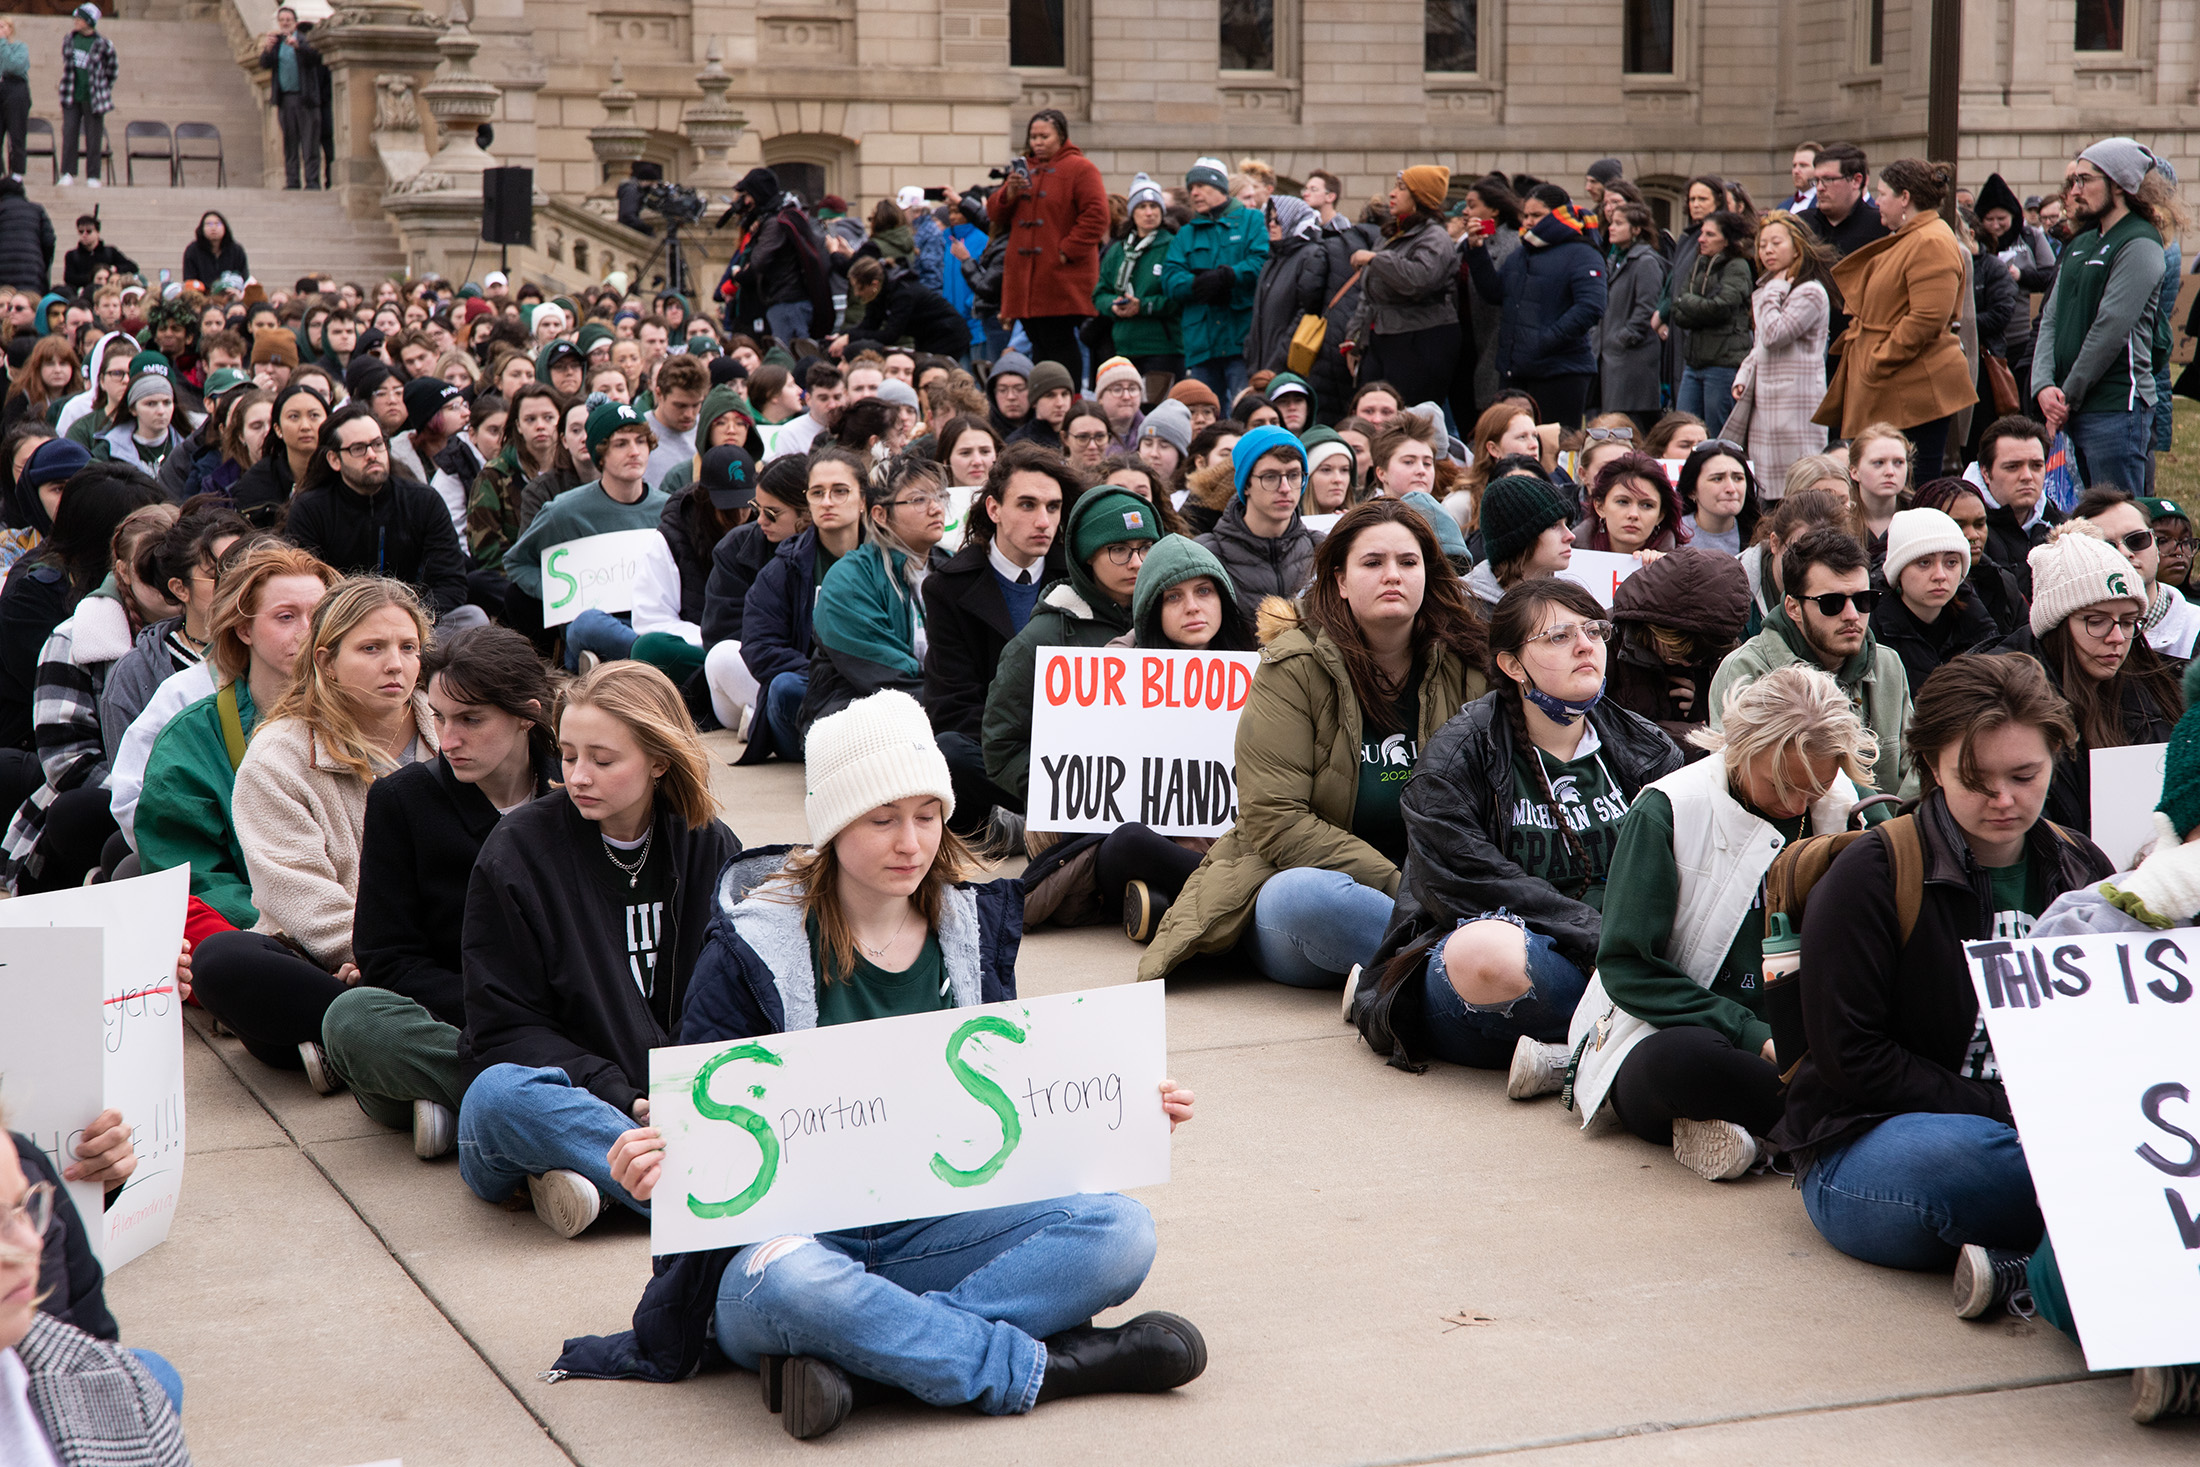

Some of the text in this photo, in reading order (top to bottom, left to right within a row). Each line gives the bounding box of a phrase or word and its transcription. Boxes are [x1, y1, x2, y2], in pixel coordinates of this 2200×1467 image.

[1045, 655, 1253, 711] OUR BLOOD
[1040, 754, 1125, 822] YOUR
[1966, 938, 2193, 1009] THIS IS
[687, 1014, 1123, 1219] Spartan Strong
